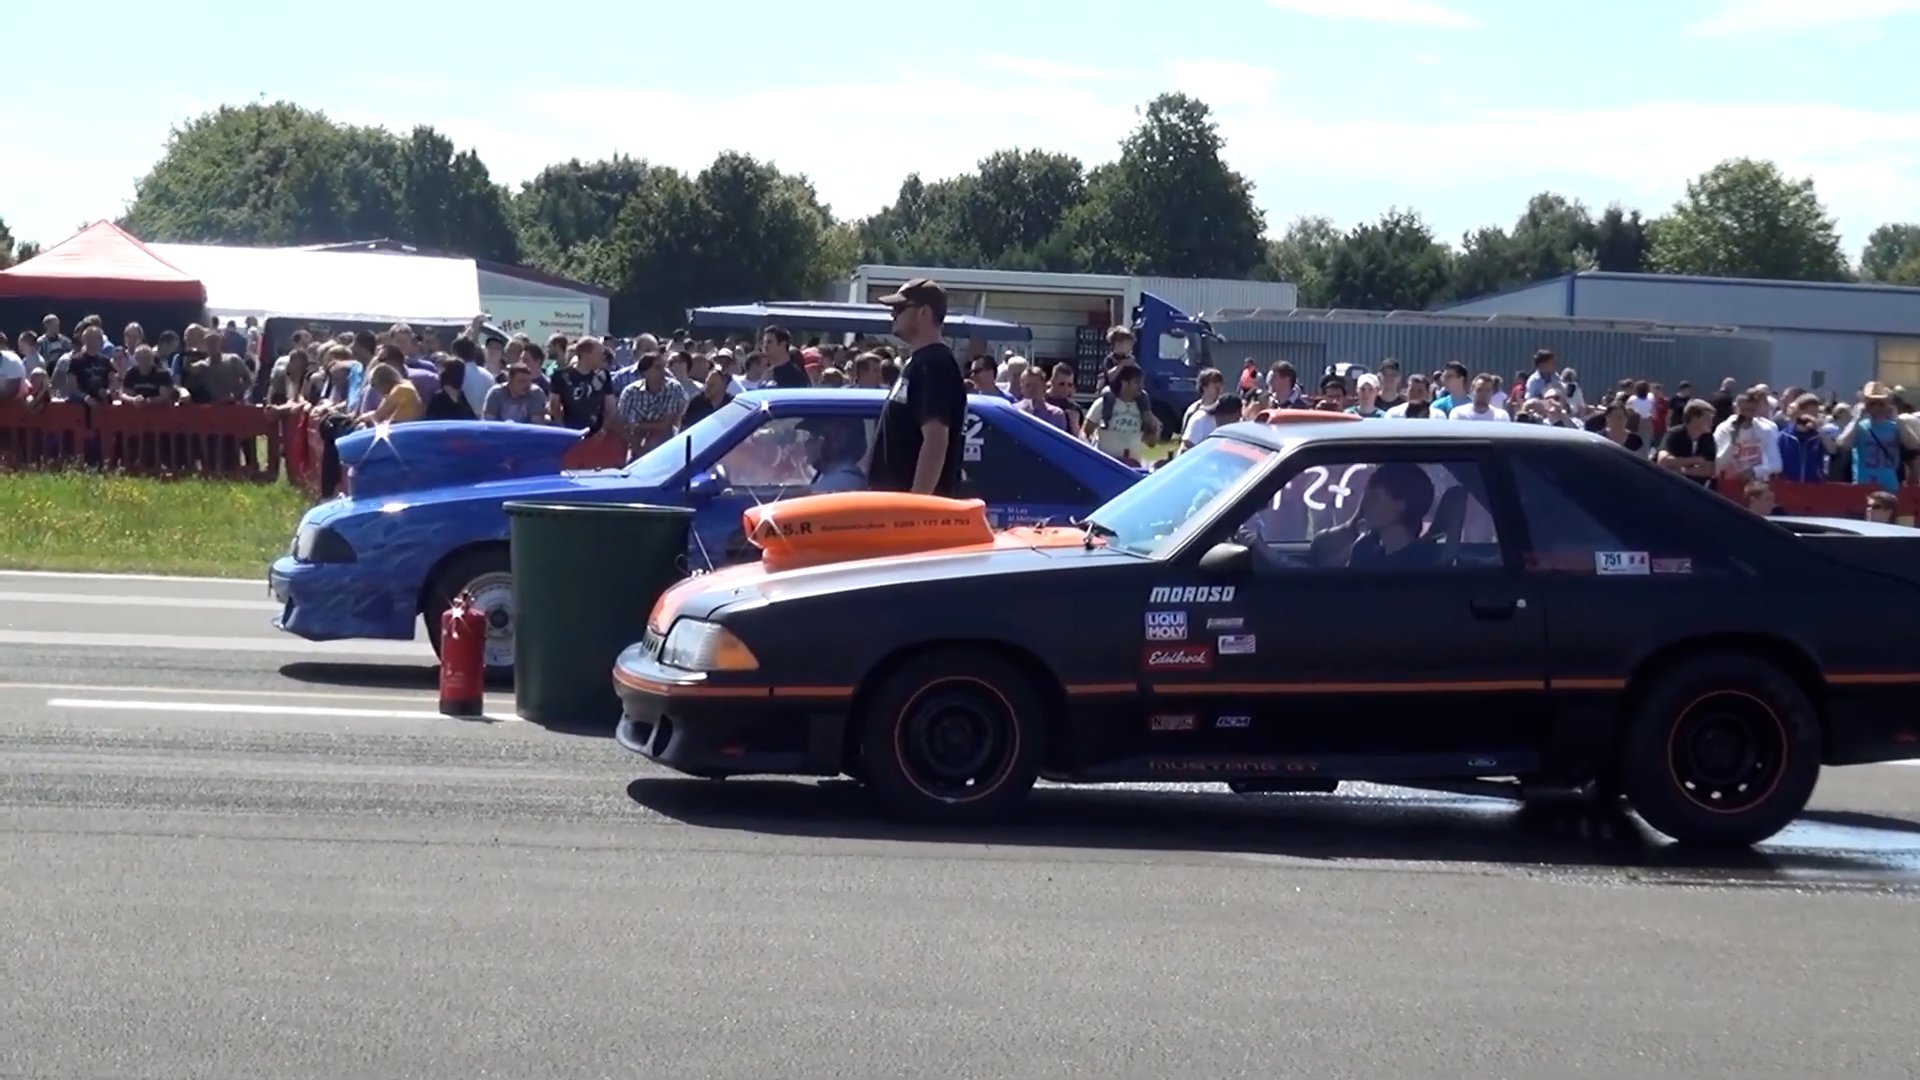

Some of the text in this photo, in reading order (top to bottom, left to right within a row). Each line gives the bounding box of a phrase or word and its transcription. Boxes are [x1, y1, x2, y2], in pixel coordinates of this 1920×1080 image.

[1601, 552, 1623, 567] 751
[1149, 586, 1236, 603] MOROSO
[1148, 613, 1184, 626] LIQUI
[1148, 626, 1186, 638] MOLY
[1148, 650, 1207, 665] Edelbrock
